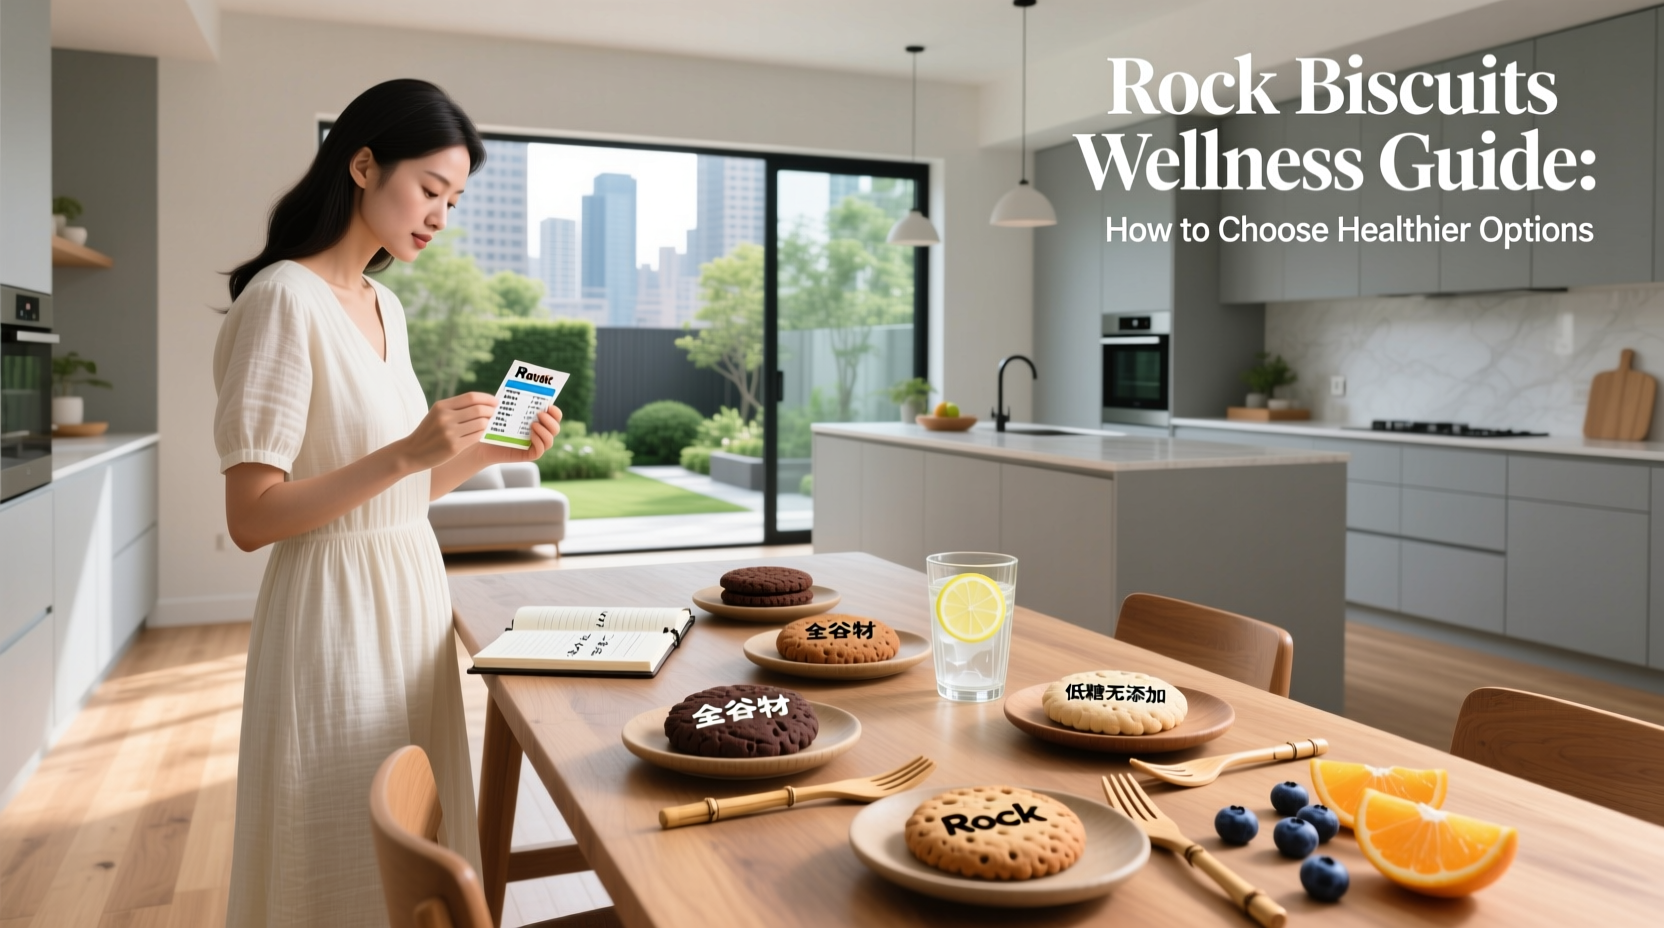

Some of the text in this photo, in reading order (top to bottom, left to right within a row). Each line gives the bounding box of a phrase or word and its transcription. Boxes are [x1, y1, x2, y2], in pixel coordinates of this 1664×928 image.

[1065, 683, 1166, 704] 低糖无添加
[941, 803, 1048, 836] Rock
